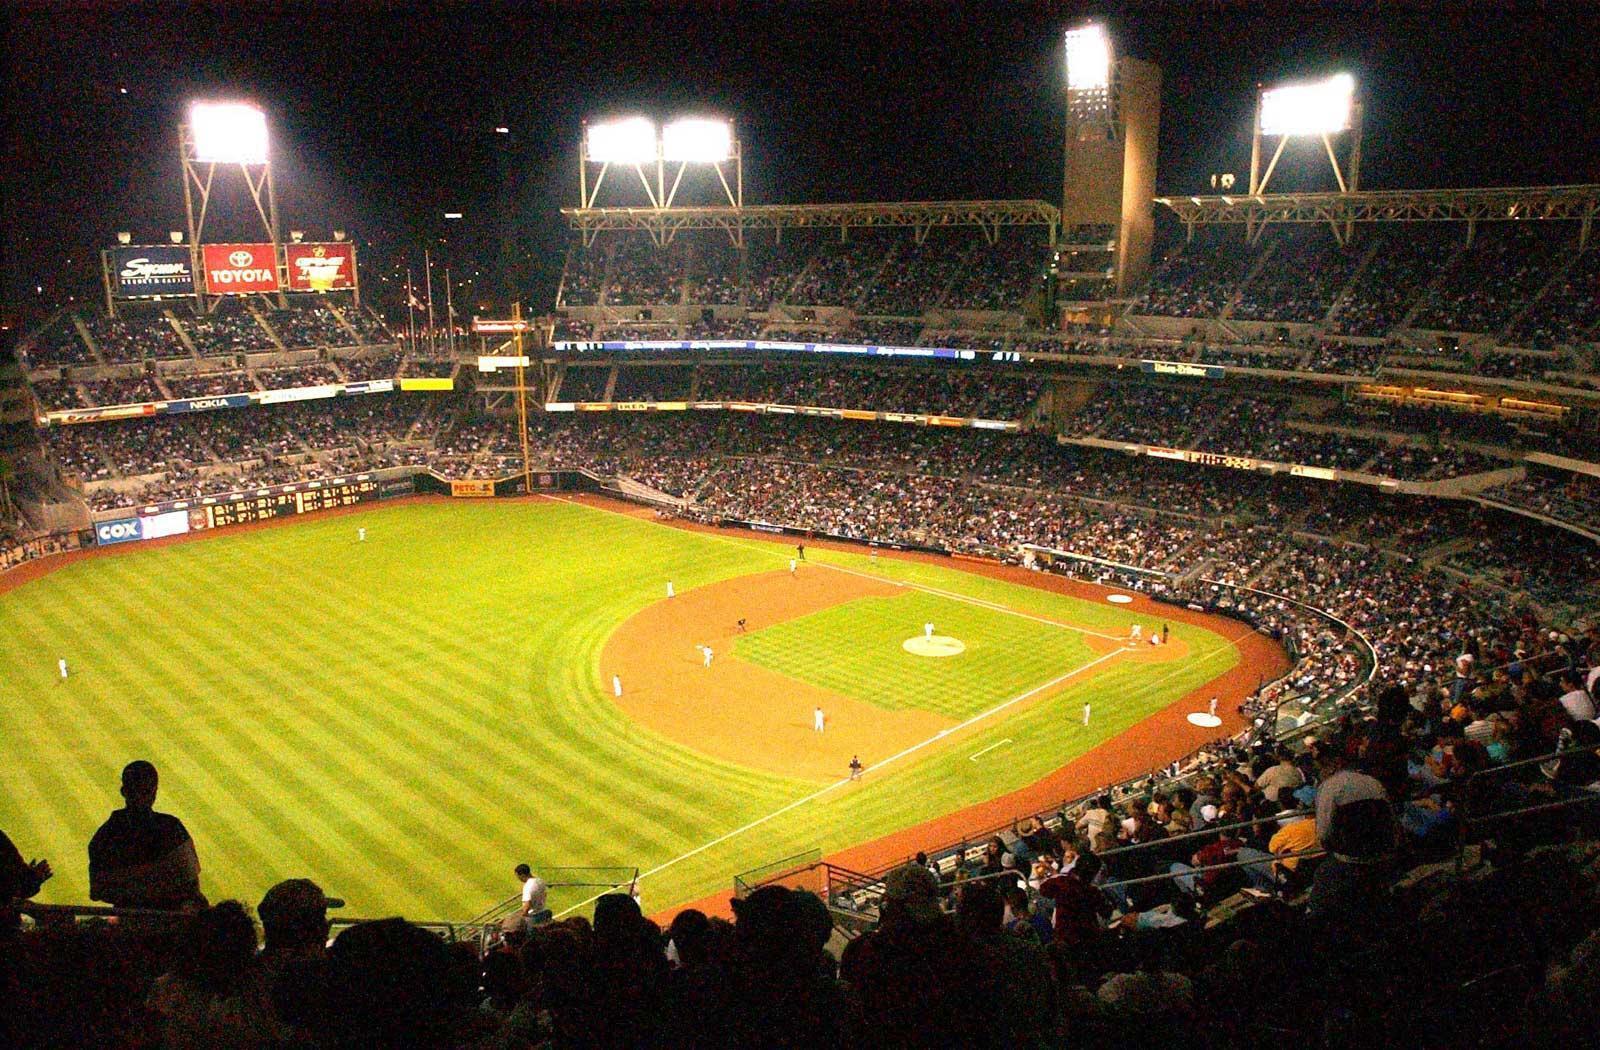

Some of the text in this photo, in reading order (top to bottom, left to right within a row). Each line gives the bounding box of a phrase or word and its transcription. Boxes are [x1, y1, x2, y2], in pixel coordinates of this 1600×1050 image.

[211, 269, 273, 283] TOYOTA
[190, 398, 229, 410] NOKIA
[99, 522, 138, 540] COX
